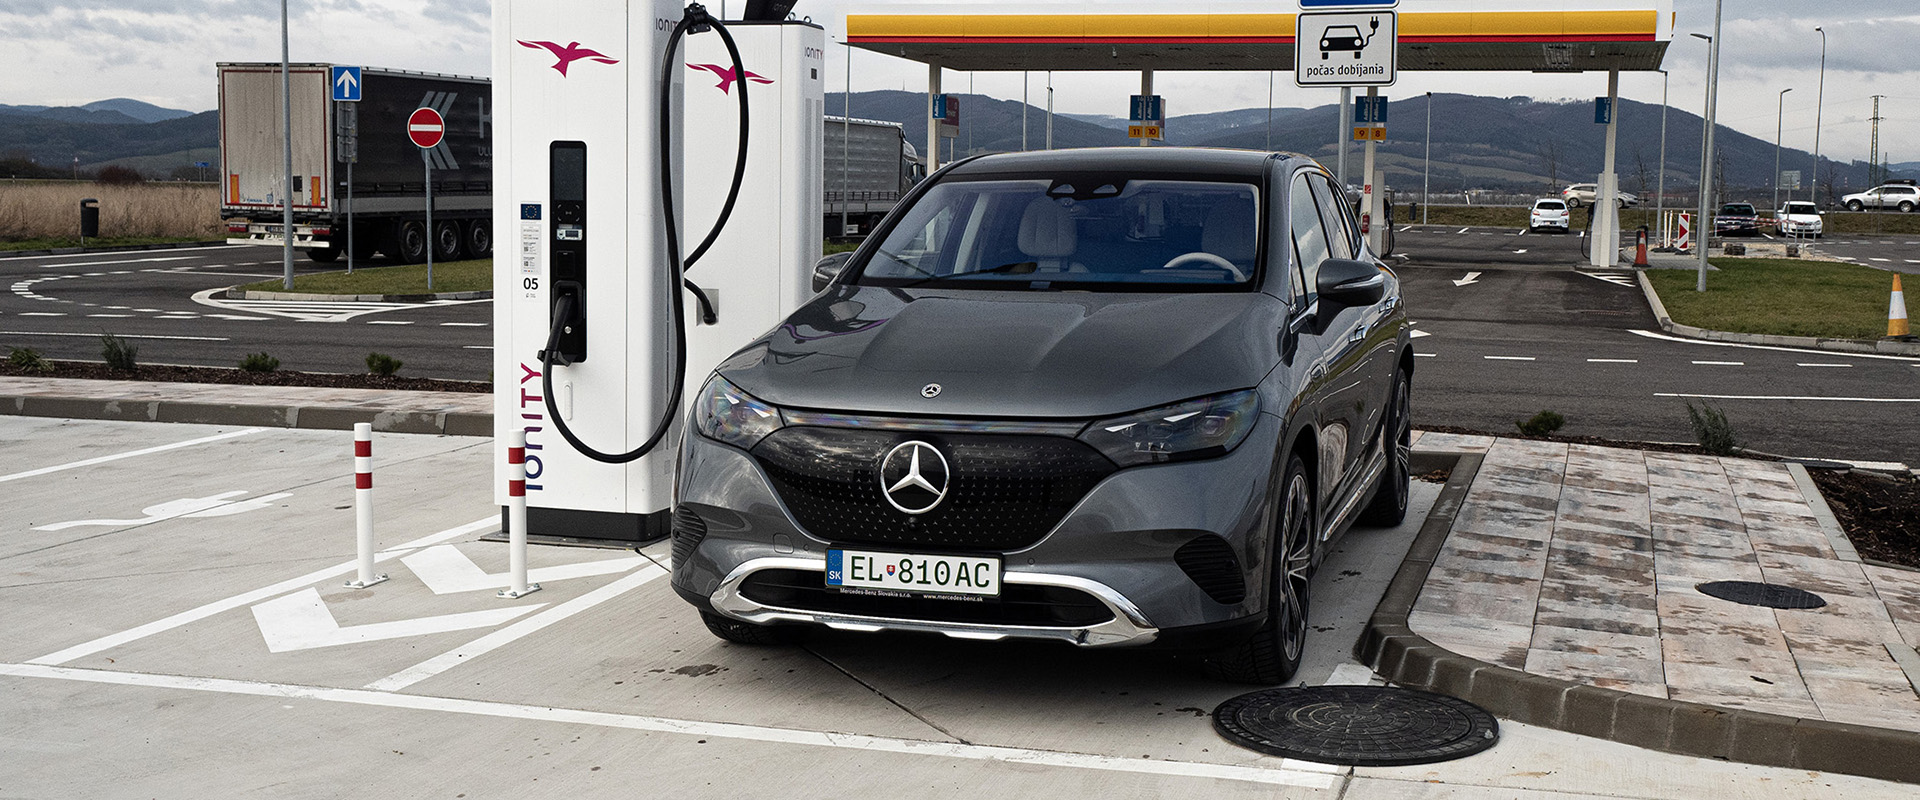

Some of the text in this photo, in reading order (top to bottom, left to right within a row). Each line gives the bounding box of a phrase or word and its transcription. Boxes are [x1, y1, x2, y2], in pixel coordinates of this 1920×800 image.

[656, 18, 678, 32] IONIT
[804, 46, 824, 61] IONITY
[1306, 63, 1384, 78] počas dobíjania
[1133, 128, 1140, 136] 11
[1148, 128, 1157, 136] 10
[1375, 130, 1381, 138] 8
[523, 277, 539, 290] 05
[520, 362, 543, 491] IONITY
[851, 555, 883, 582] EL
[828, 570, 841, 580] SK
[840, 587, 877, 596] Mercedes-Benz
[923, 594, 983, 602] www.mercedes-benz.sk
